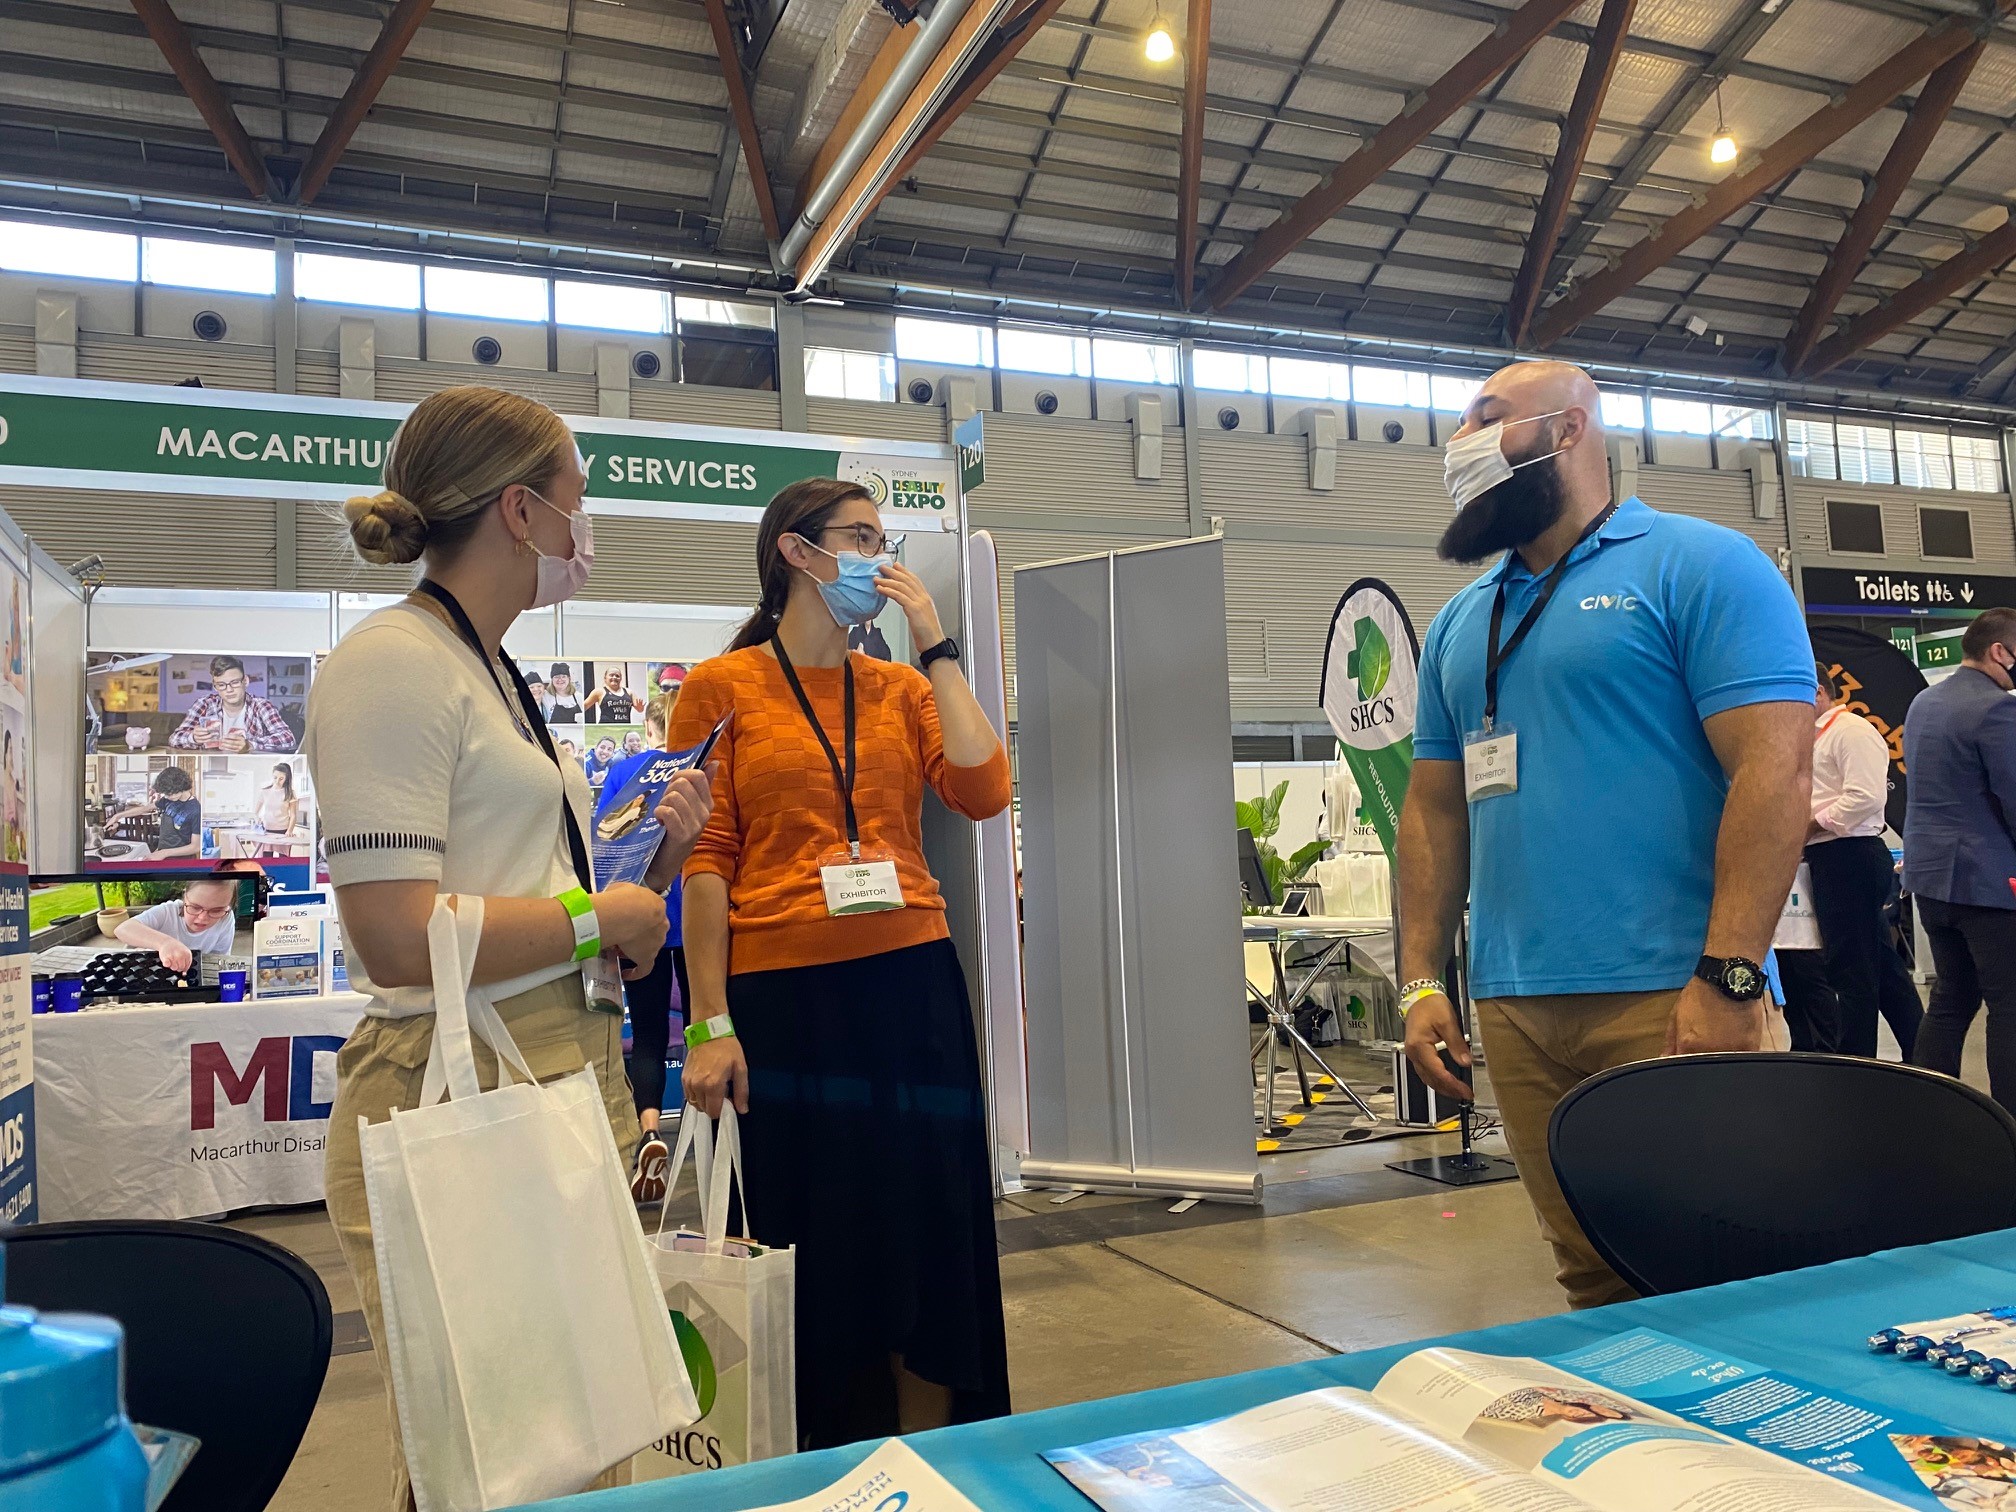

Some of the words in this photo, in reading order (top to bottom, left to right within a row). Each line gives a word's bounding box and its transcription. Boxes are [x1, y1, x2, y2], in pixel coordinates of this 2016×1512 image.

[157, 426, 394, 468] MACARTHU
[607, 454, 757, 491] SERVICES
[962, 440, 982, 471] 120
[891, 470, 918, 478] SYDNEY
[892, 493, 946, 510] EXPO
[1855, 576, 1920, 602] Toilets
[1580, 594, 1637, 610] CIVIC
[1895, 638, 1911, 651] 121
[1926, 646, 1949, 662] 121
[1350, 697, 1395, 733] SHCS
[651, 752, 695, 769] National
[639, 767, 680, 784] 360
[1474, 768, 1507, 782] EXHIBITOR
[1353, 826, 1377, 836] SHCS
[840, 888, 887, 899] EXHIBITOR
[265, 937, 311, 946] COORDINATION
[1347, 1020, 1368, 1029] SHCS
[190, 1139, 280, 1163] Macarthur
